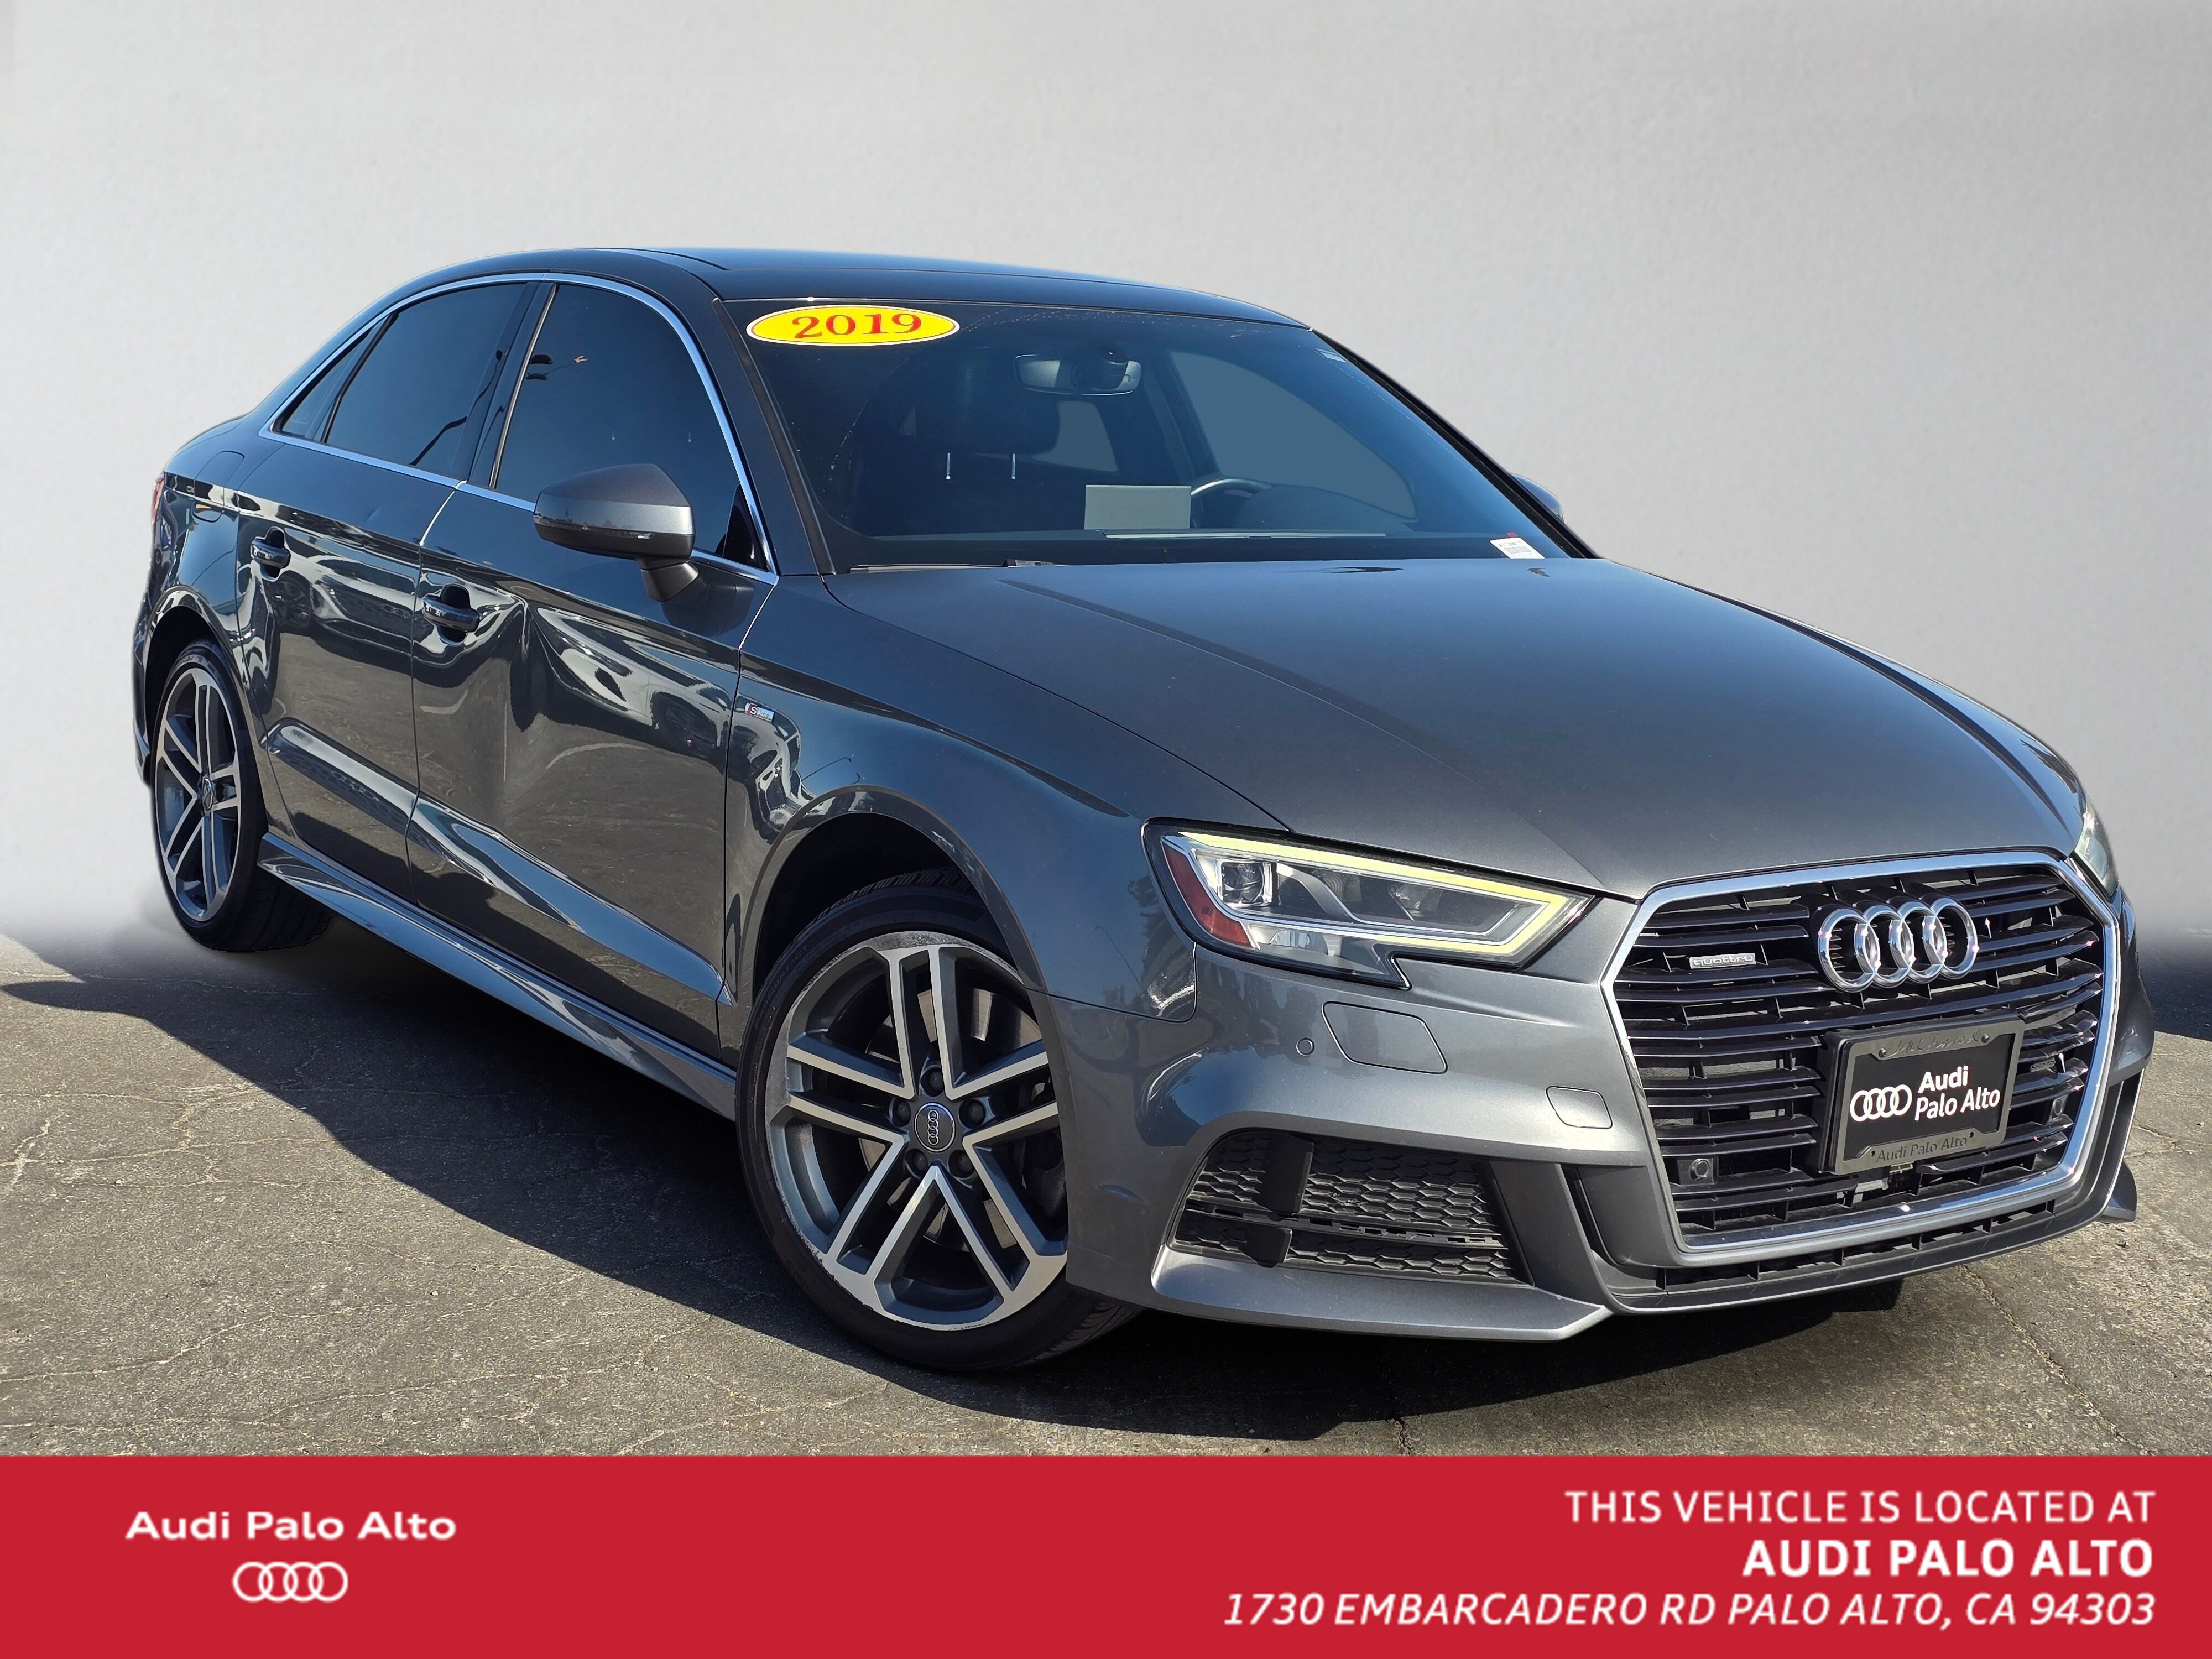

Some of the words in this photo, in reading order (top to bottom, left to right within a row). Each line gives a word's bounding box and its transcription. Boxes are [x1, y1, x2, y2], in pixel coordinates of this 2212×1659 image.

[792, 314, 922, 338] 2019
[750, 707, 758, 715] S
[1693, 956, 1753, 967] quattro
[1918, 1066, 1969, 1093] Audi
[1914, 1093, 1957, 1121] Palo
[1960, 1087, 2001, 1113] Alto
[1876, 1146, 1907, 1162] Audi
[1910, 1141, 1938, 1157] Palo
[1940, 1136, 1968, 1151] Alto
